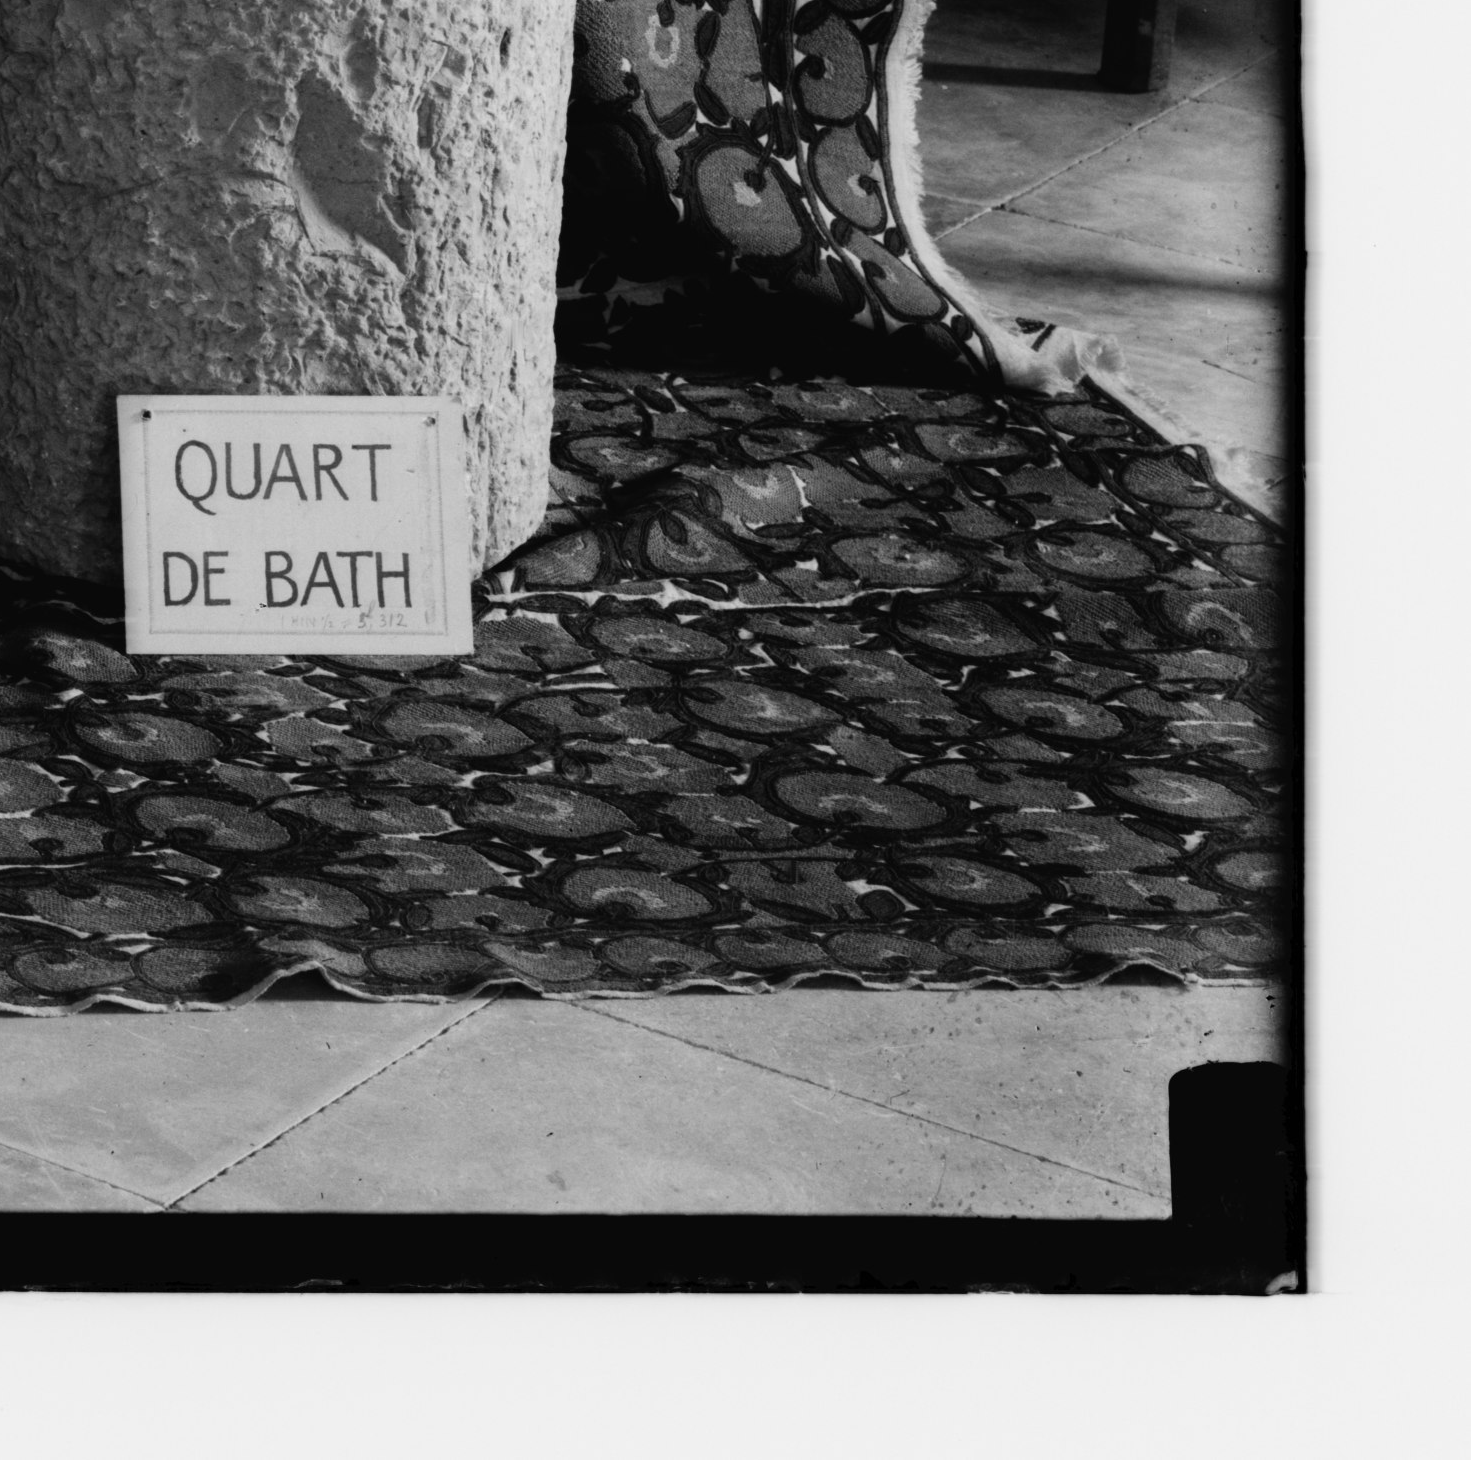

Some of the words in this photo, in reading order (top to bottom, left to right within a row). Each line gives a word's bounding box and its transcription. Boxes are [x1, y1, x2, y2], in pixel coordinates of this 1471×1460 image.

[175, 440, 391, 515] QUART
[163, 552, 231, 606] DE
[264, 551, 413, 609] BATH
